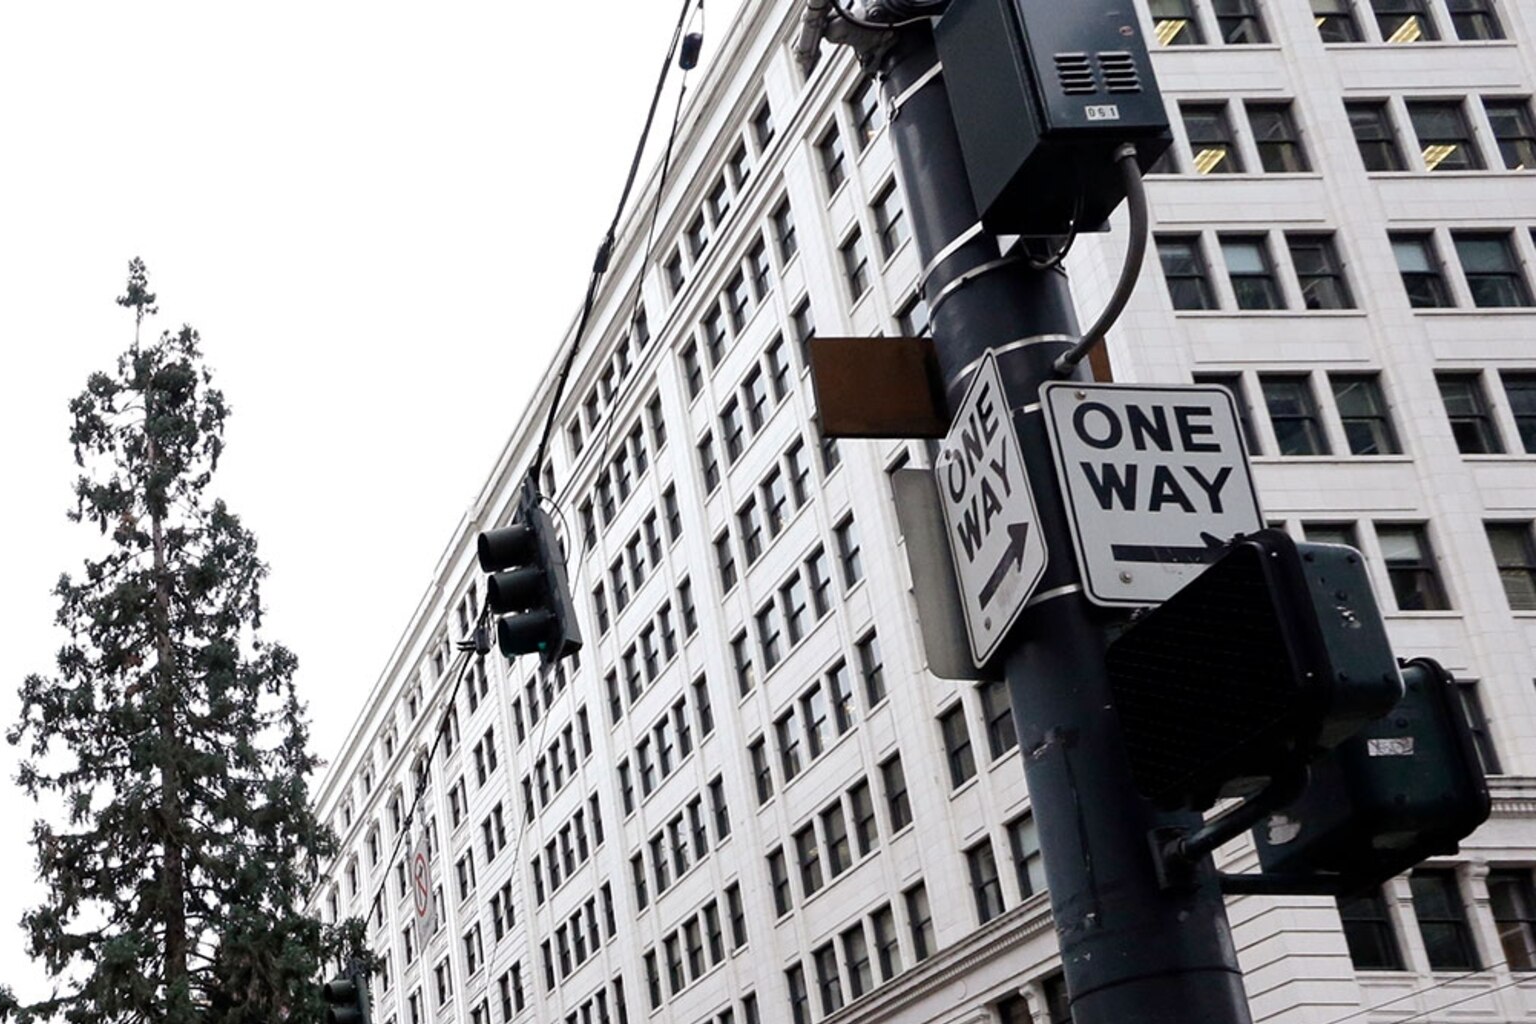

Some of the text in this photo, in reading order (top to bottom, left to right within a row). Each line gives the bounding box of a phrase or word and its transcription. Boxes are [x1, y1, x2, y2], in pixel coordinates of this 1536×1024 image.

[948, 381, 1000, 504] ONE
[1072, 401, 1222, 453] ONE
[957, 435, 1013, 563] WAY
[1080, 461, 1233, 514] WAY
